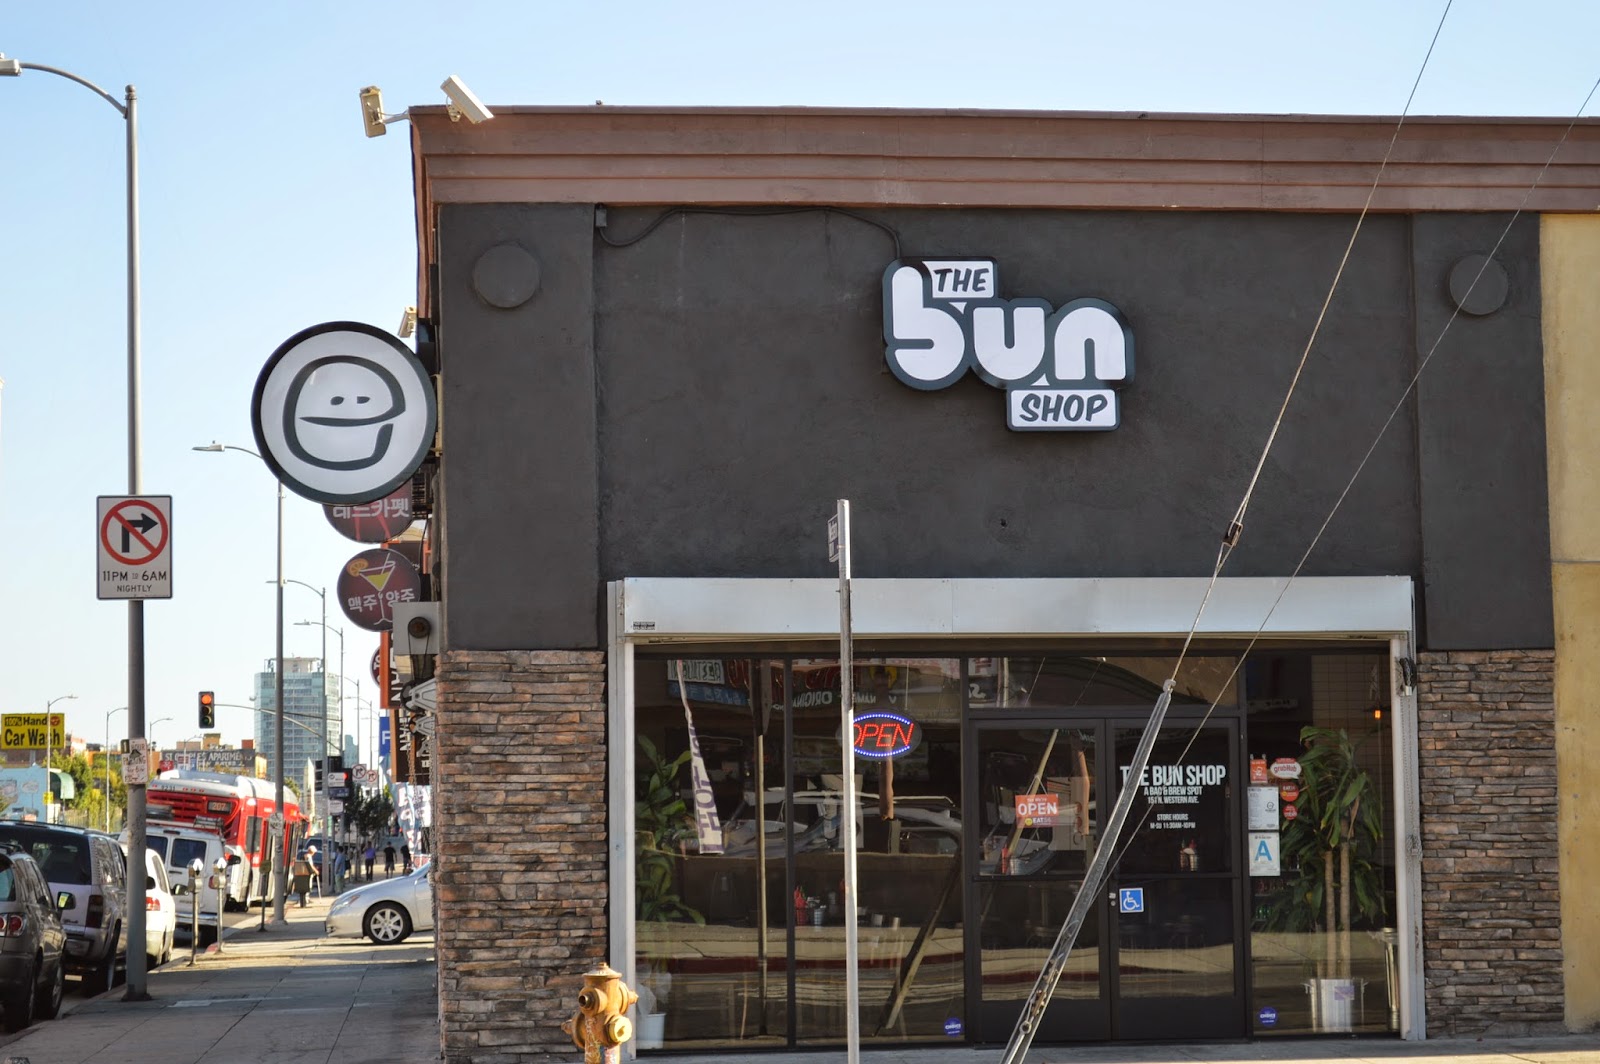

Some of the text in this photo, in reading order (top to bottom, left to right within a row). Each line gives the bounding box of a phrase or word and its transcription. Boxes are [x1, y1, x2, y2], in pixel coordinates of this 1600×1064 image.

[933, 267, 989, 292] THE
[892, 266, 1126, 380] bun
[1019, 393, 1108, 422] SHOP
[103, 571, 128, 581] 11PM
[142, 571, 167, 581] 6AM
[348, 594, 377, 612] 맥주
[23, 716, 48, 726] Hand
[5, 729, 25, 746] Car
[1120, 765, 1226, 786] TE BUN SHOP
[1144, 786, 1149, 795] A
[1168, 786, 1187, 795] BREW
[1187, 786, 1203, 795] SPOT
[212, 802, 226, 810] 207
[1163, 796, 1187, 804] WESTERN
[1018, 803, 1057, 815] OPEN
[1255, 840, 1272, 860] A
